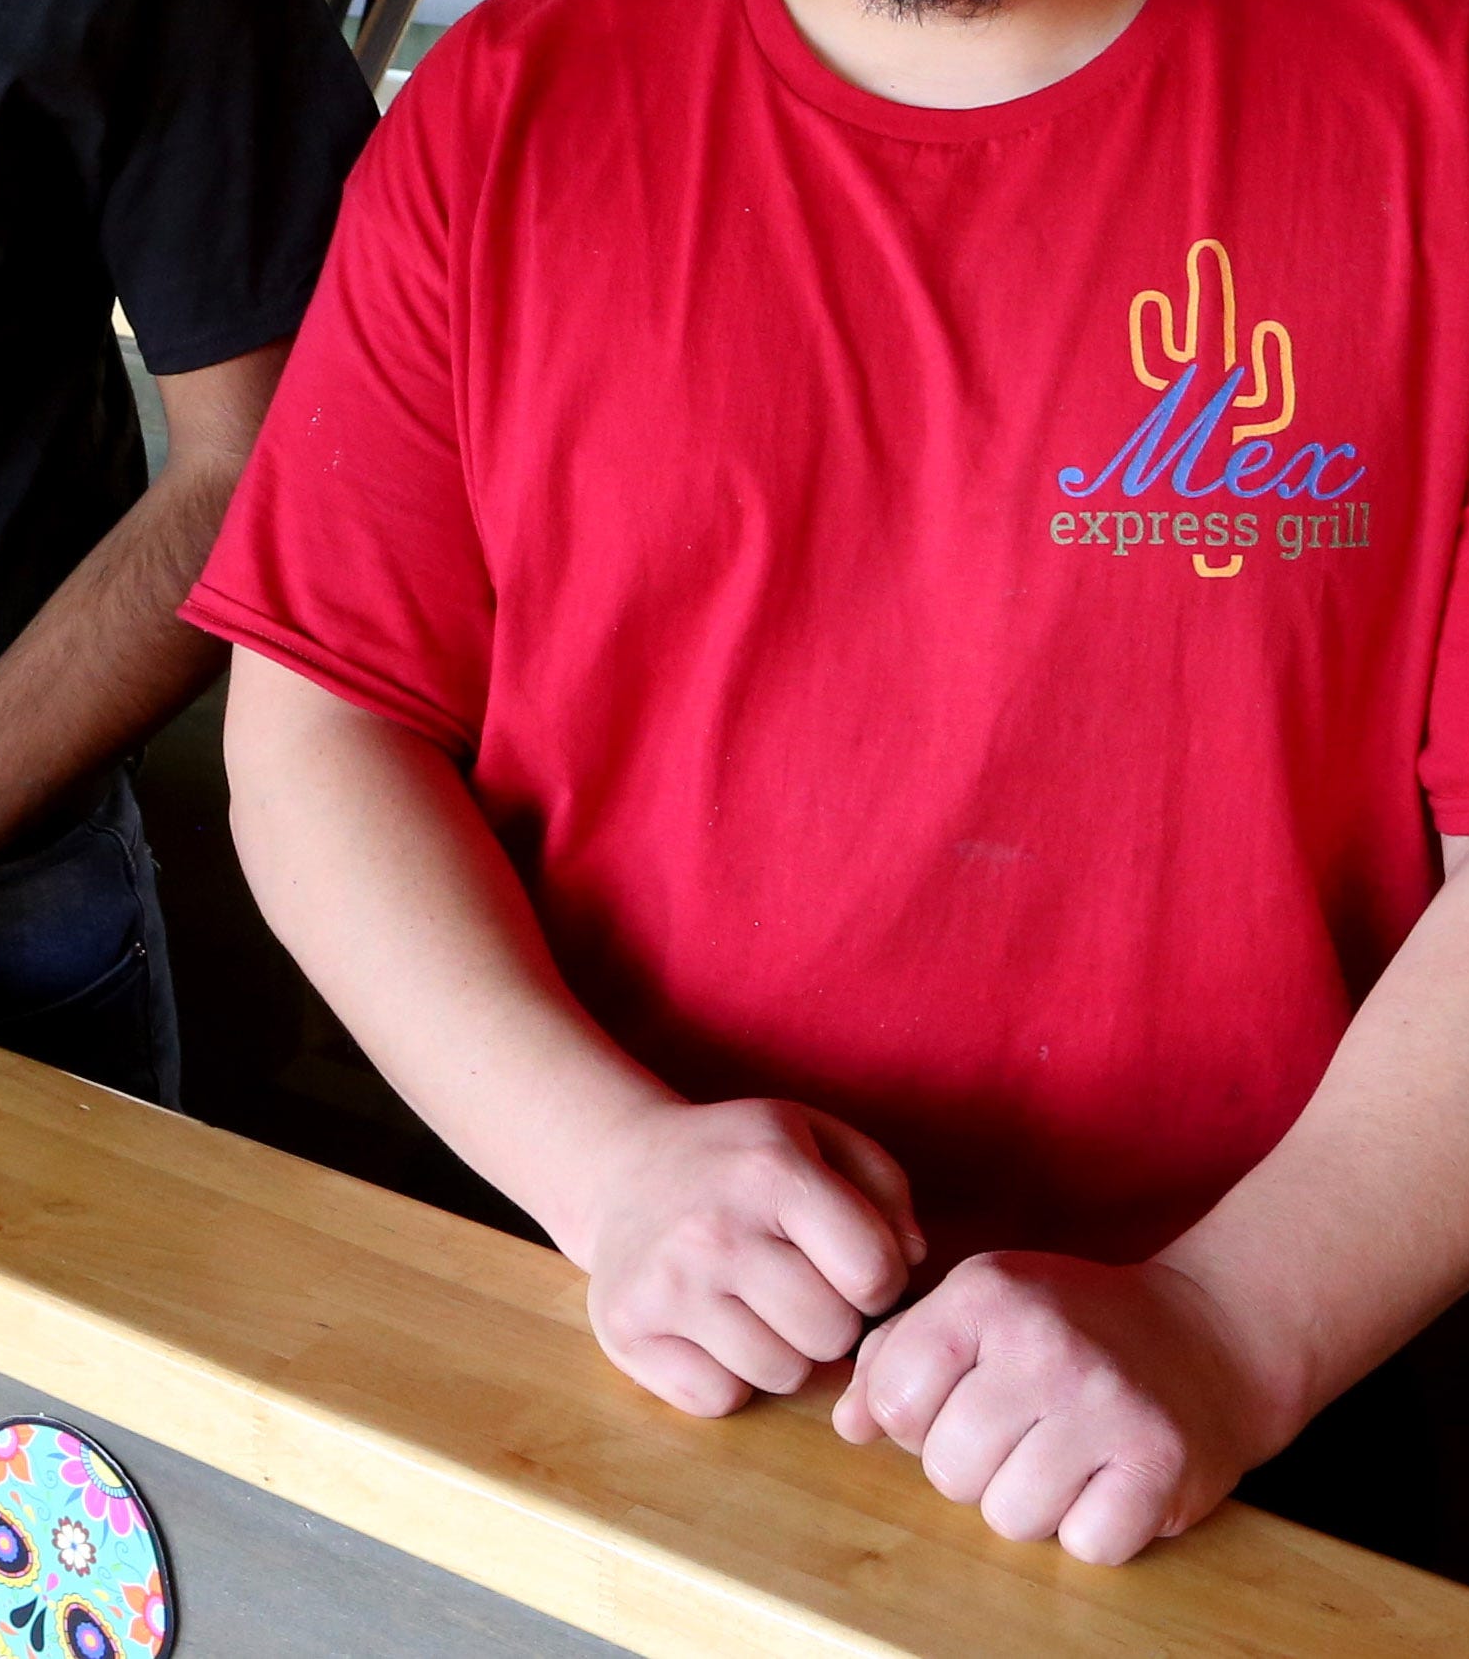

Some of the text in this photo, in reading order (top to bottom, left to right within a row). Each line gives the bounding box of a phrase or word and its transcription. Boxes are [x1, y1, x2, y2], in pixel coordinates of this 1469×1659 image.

[1057, 363, 1367, 500] Mex
[1050, 502, 1370, 561] express grill
